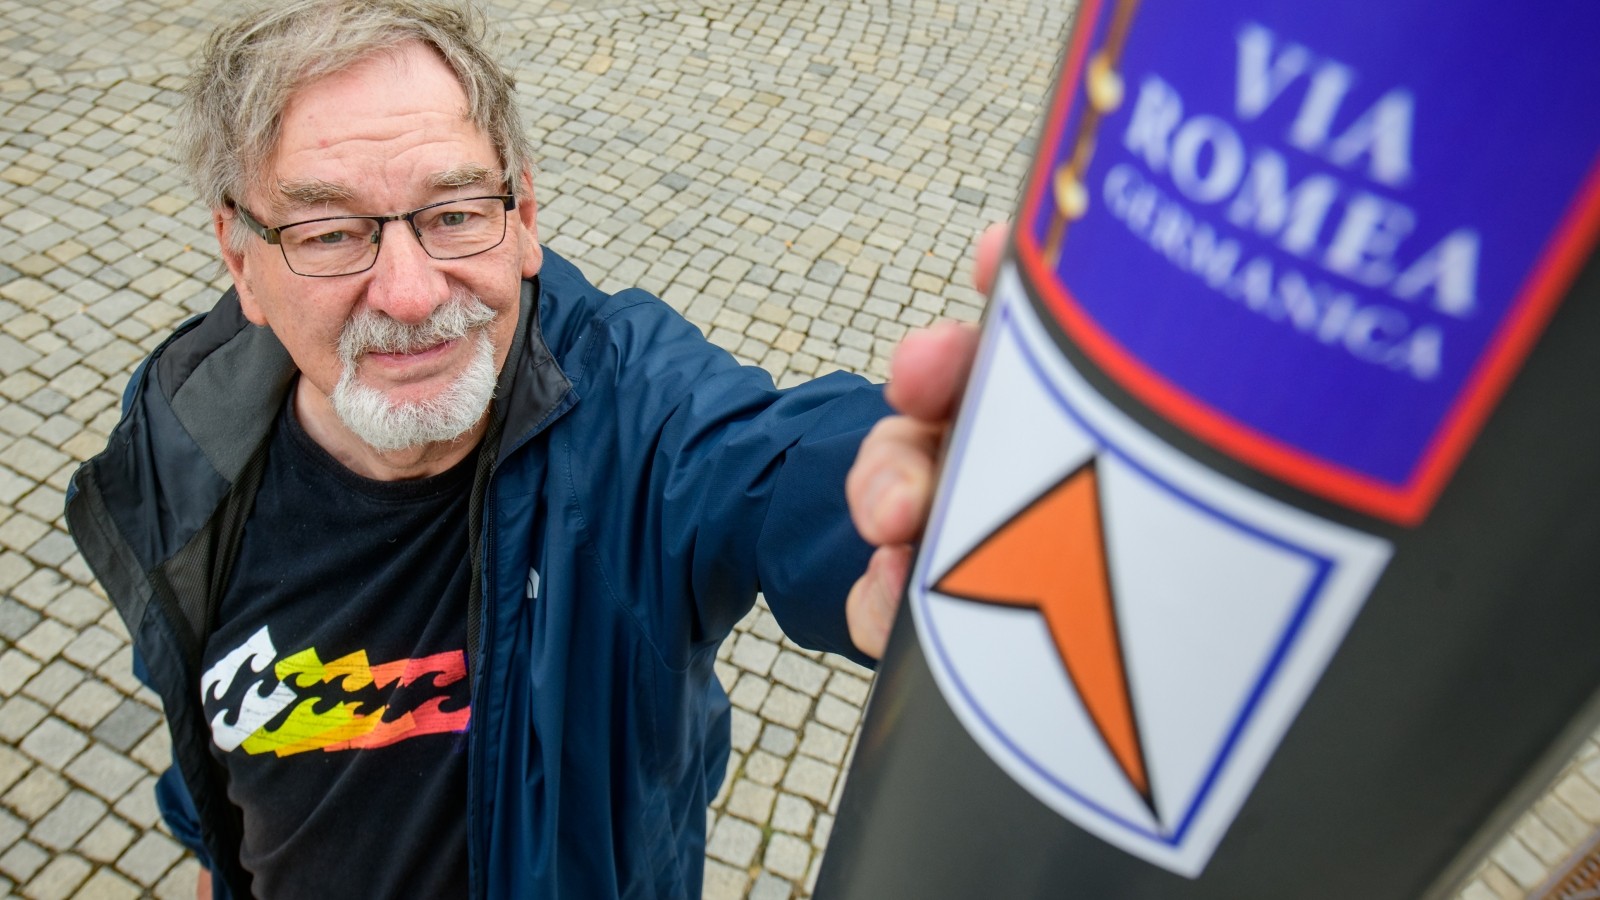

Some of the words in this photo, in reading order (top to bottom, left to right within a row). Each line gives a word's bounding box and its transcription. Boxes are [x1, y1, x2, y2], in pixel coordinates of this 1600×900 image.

[1124, 75, 1480, 316] ROMEA
[1236, 23, 1415, 187] VIA
[1103, 165, 1442, 379] GERMANICA
